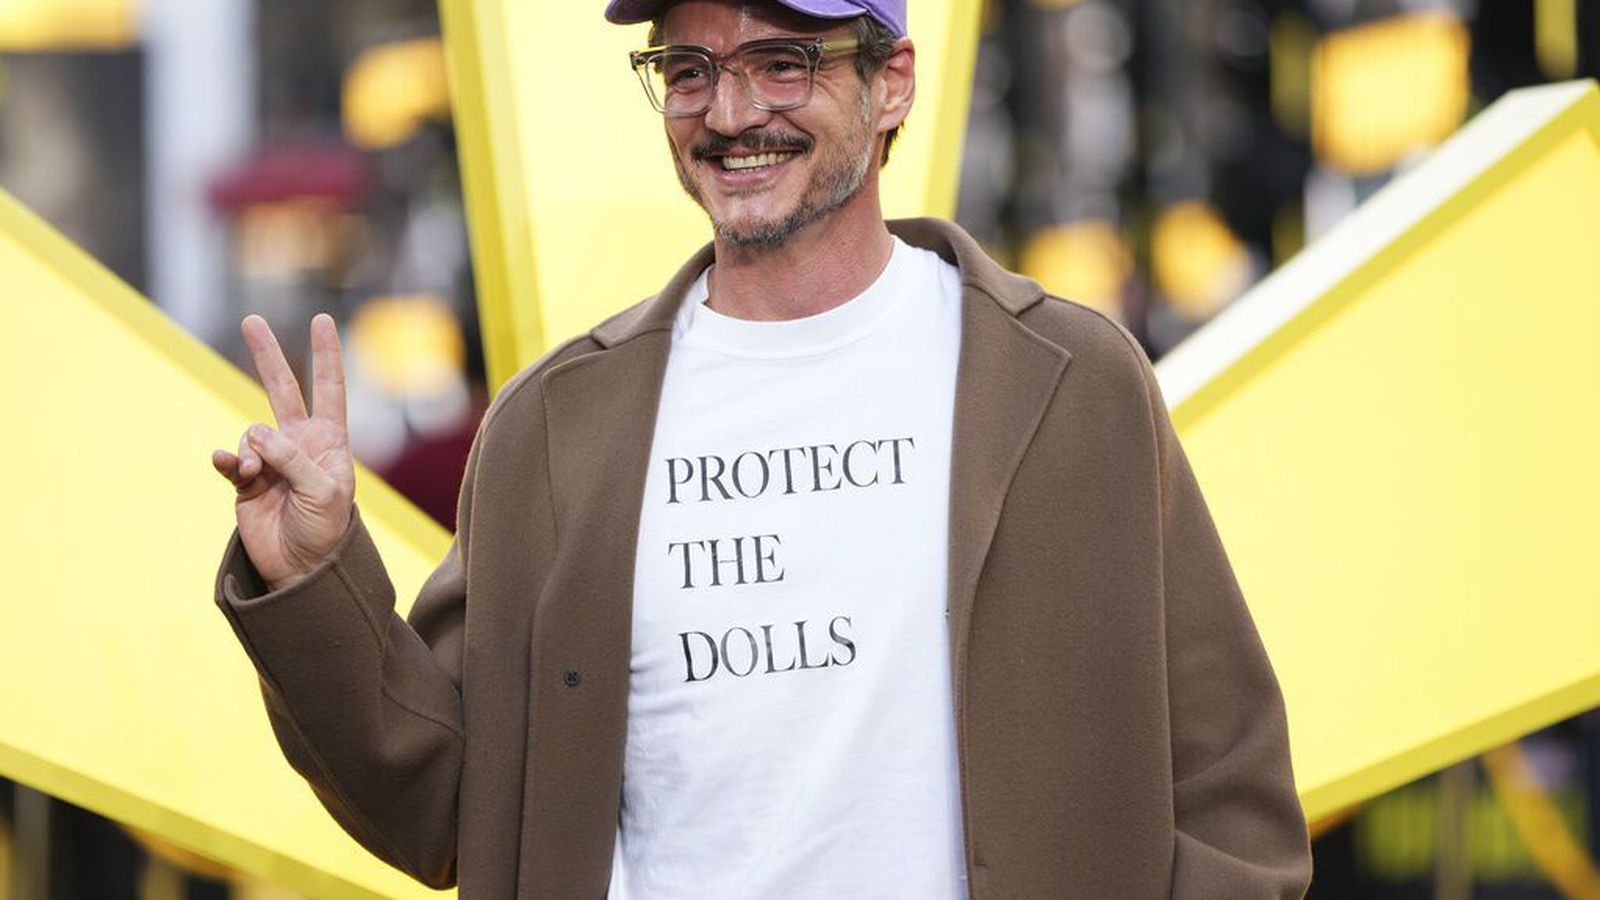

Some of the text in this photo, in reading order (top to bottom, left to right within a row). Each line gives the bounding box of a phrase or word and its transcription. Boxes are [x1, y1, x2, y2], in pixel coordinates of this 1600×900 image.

[665, 437, 915, 504] PROTECT
[668, 534, 785, 589] THE
[678, 616, 856, 683] DOLLS
